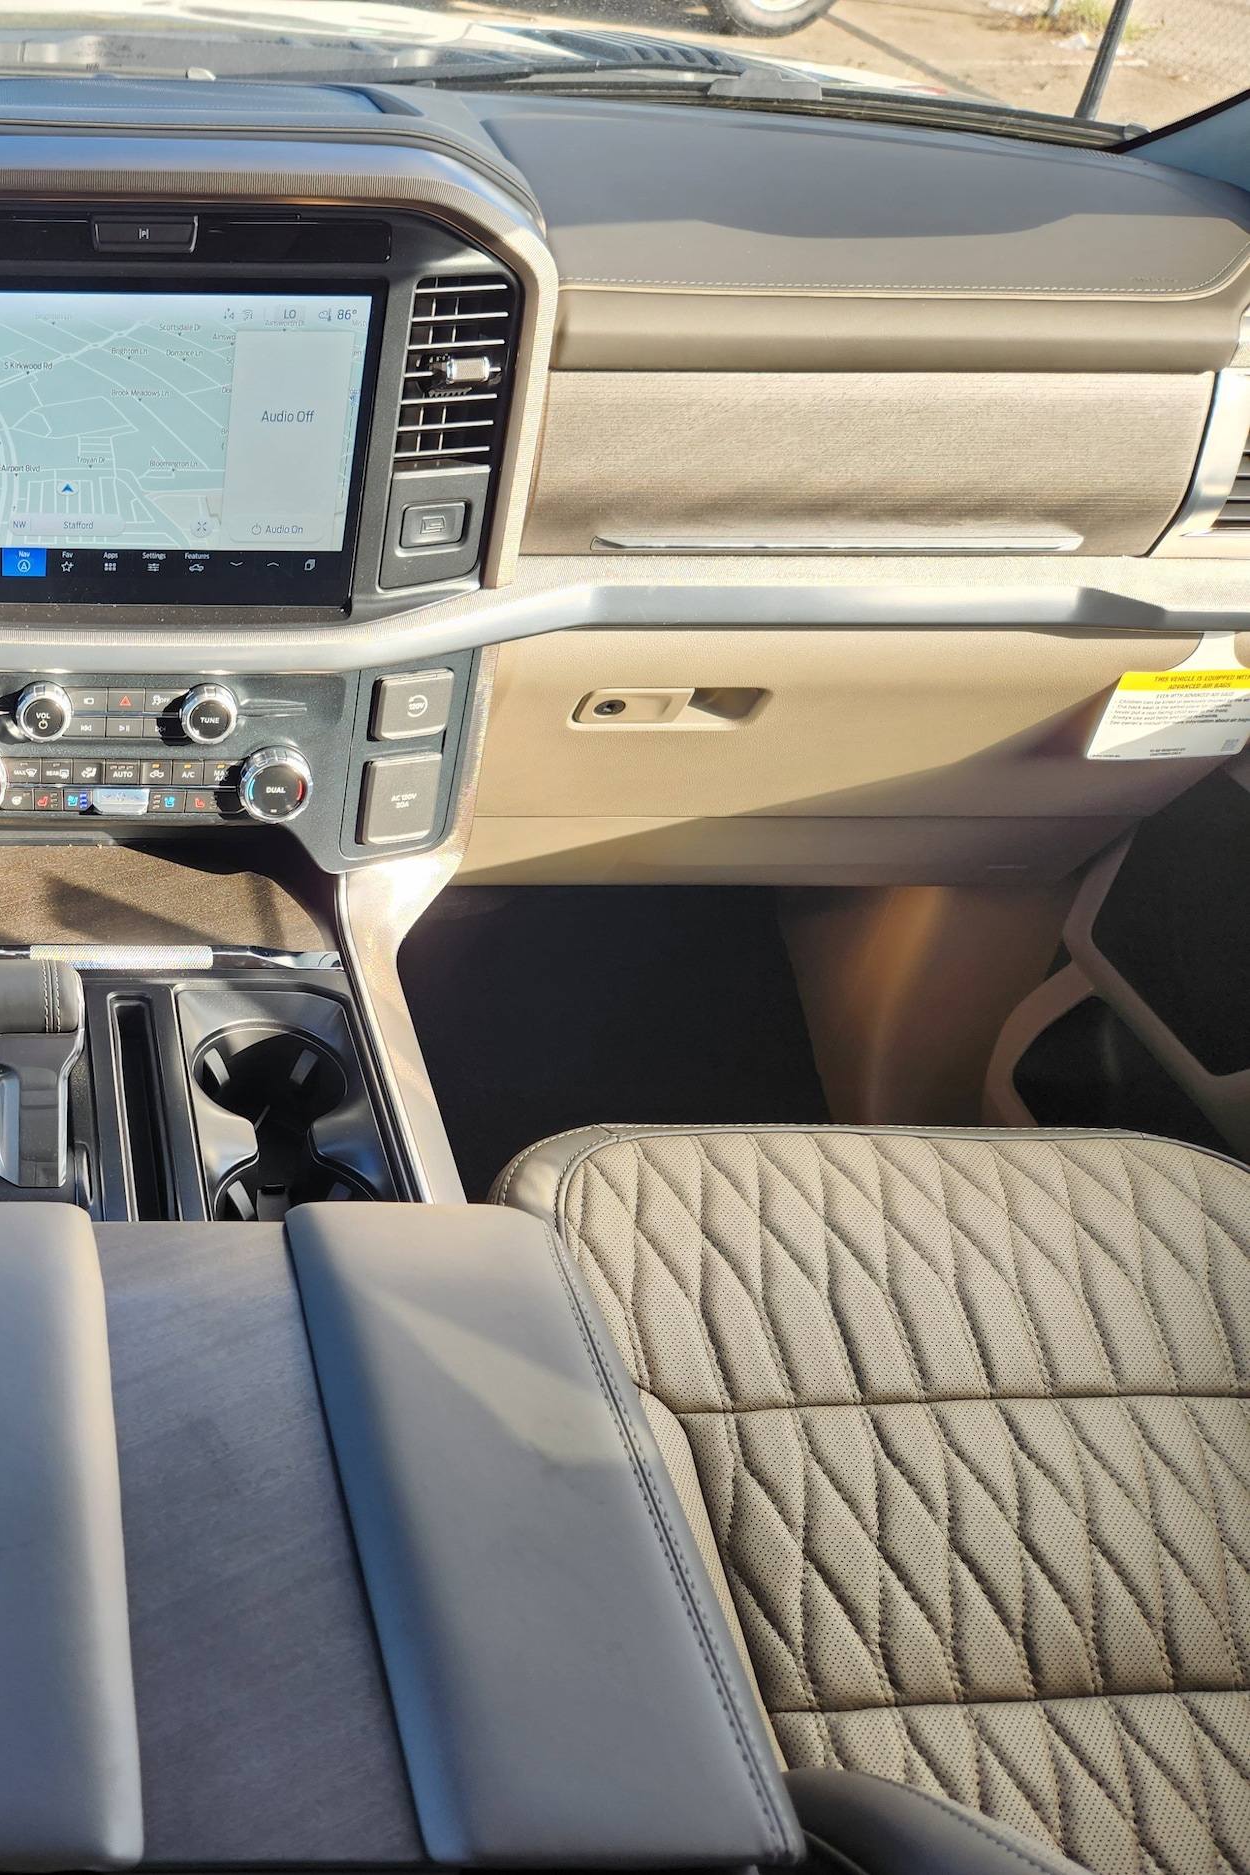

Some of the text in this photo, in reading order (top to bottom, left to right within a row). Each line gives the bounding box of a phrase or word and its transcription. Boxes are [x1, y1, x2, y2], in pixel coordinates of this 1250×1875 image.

[283, 309, 297, 319] LO
[159, 323, 194, 331] Scottsdale
[111, 347, 138, 355] Brighton
[261, 410, 315, 423] Audio Off
[77, 456, 97, 464] Troyan
[149, 460, 189, 468] Bloomington
[1, 465, 24, 473] Airport
[63, 521, 94, 529] Stafford
[265, 525, 303, 534] Audio On
[18, 550, 31, 558] Nav
[142, 552, 166, 560] Settings
[184, 552, 210, 560] Features
[408, 702, 425, 710] 120V
[200, 716, 220, 724] TUNE
[181, 771, 196, 779] A/C
[265, 786, 287, 794] DUAL
[391, 792, 418, 802] AC 120V
